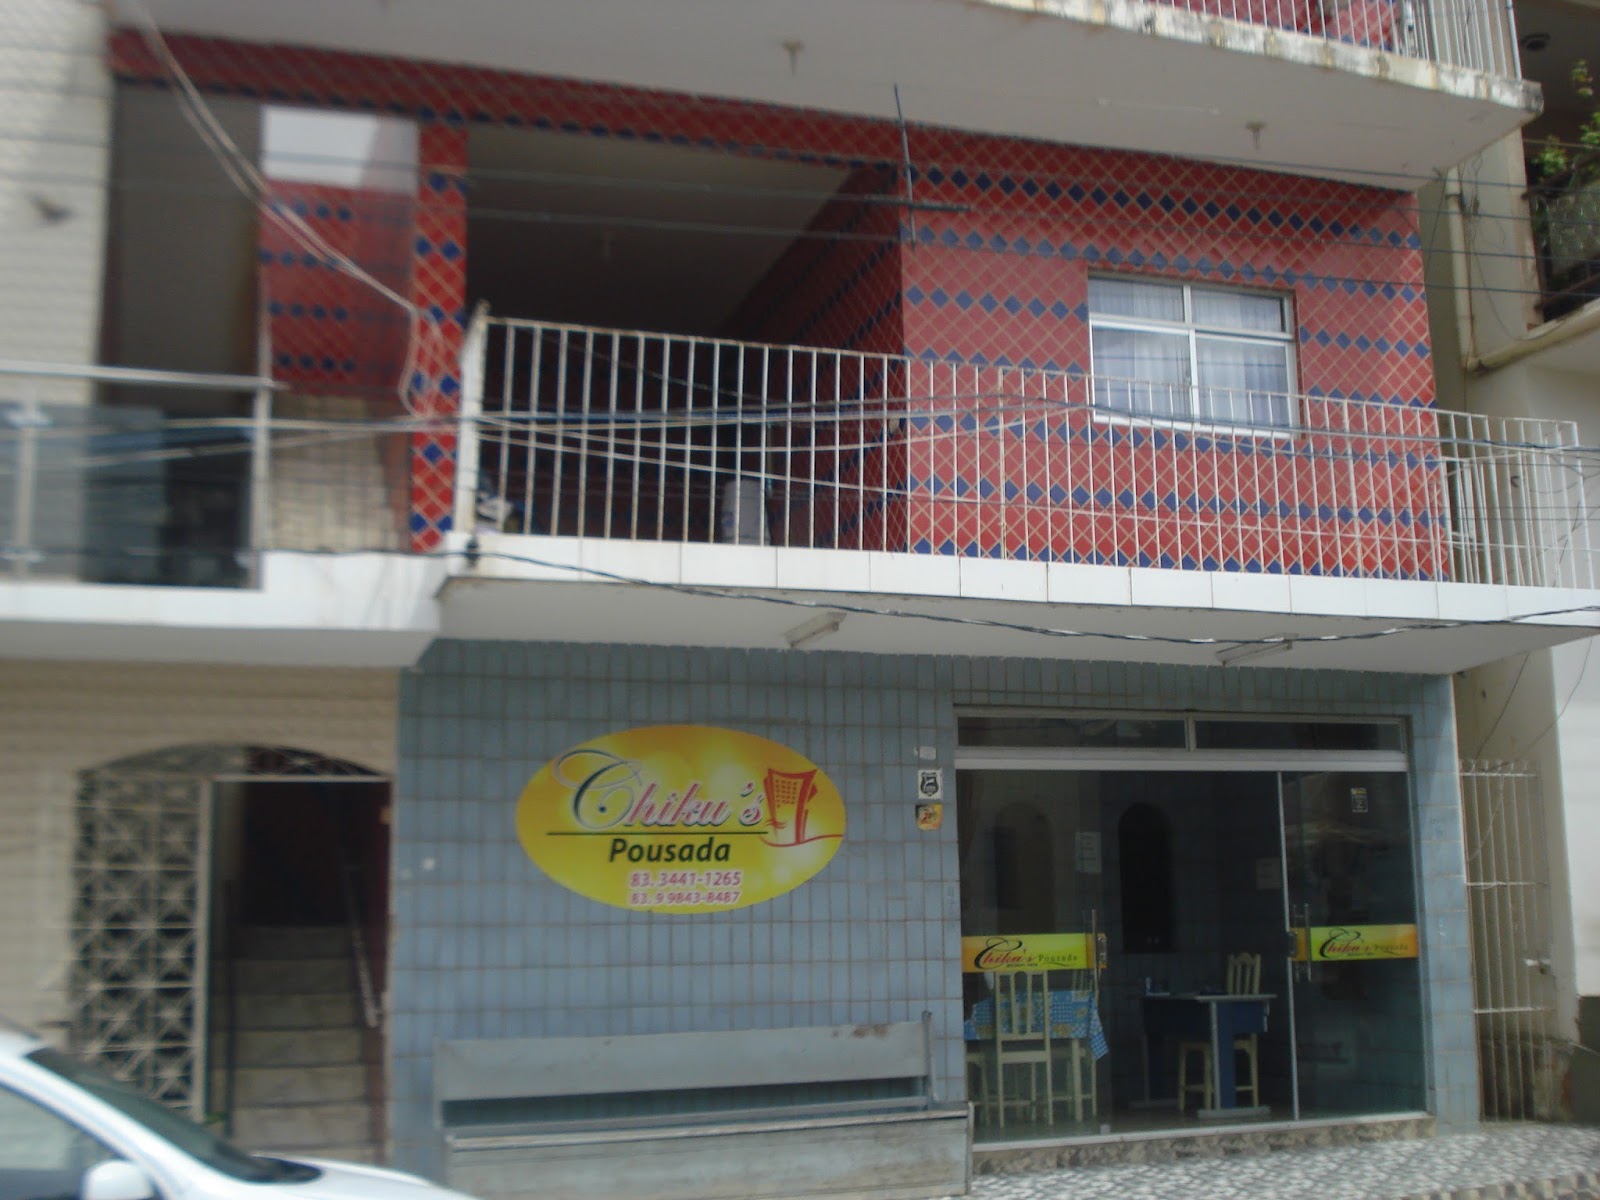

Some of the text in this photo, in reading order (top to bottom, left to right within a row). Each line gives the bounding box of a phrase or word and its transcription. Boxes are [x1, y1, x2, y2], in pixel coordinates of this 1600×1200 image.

[554, 748, 764, 832] Chiku's
[609, 836, 731, 863] Pousada
[658, 870, 743, 887] 3441-1265
